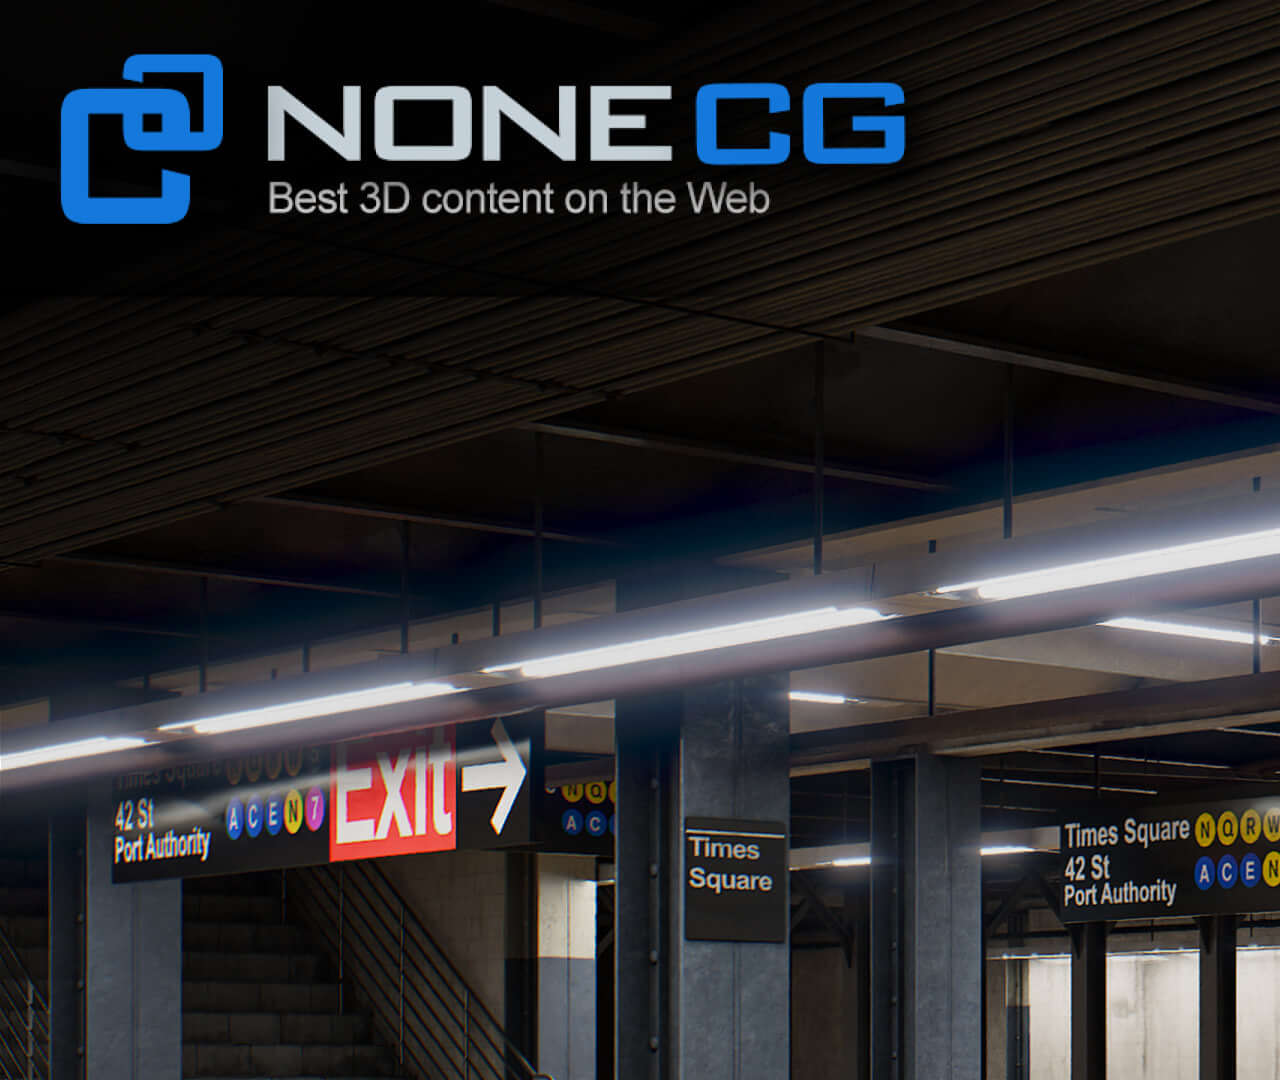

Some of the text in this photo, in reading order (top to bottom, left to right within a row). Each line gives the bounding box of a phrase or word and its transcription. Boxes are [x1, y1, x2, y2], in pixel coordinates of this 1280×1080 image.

[336, 735, 452, 845] Exit
[115, 798, 155, 832] 42 St
[114, 826, 212, 864] Port Authority
[1065, 818, 1191, 848] Times Square
[688, 836, 760, 860] Times
[689, 866, 773, 894] Square
[1065, 854, 1110, 881] 42 St
[1065, 879, 1177, 907] Port Authority
